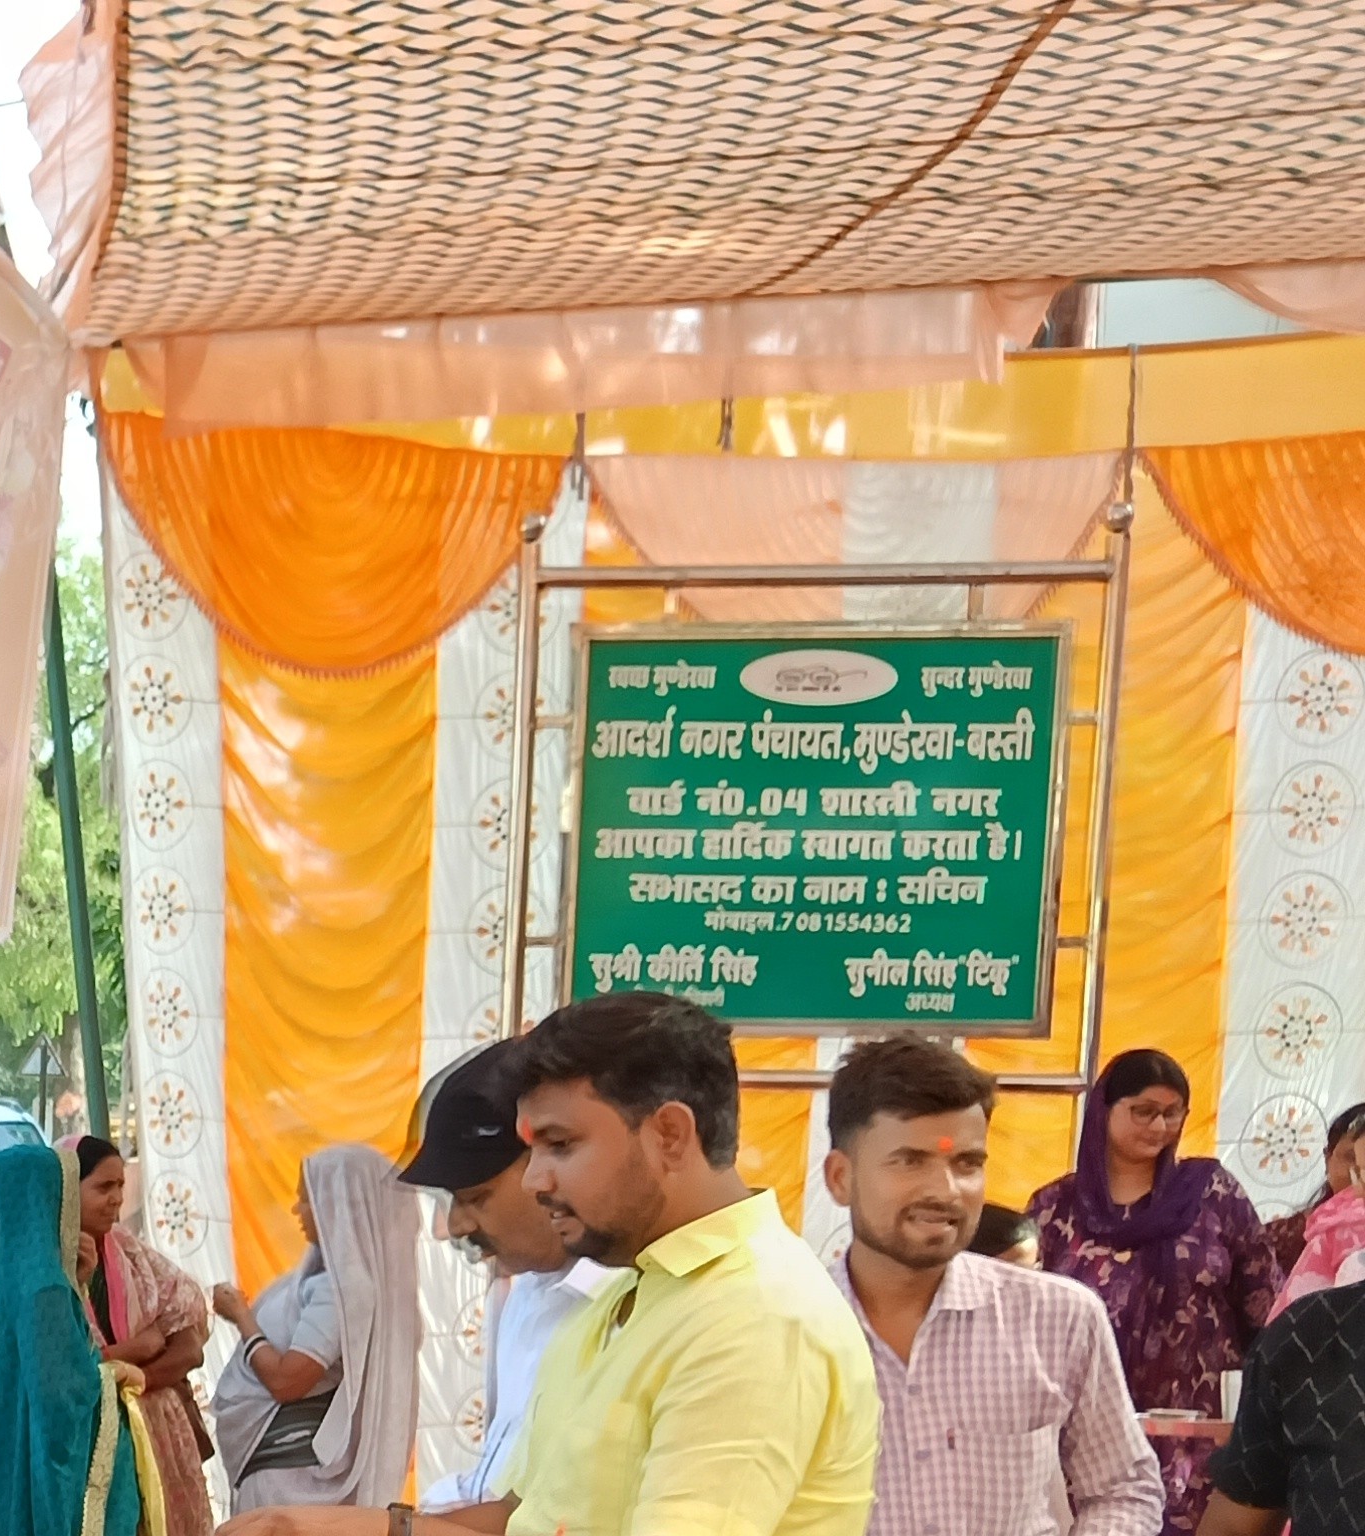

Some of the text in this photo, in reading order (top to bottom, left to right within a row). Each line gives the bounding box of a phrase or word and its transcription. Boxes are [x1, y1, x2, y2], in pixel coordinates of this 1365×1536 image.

[921, 667, 965, 697] सुन्दर
[591, 706, 676, 758] आदर्श
[680, 722, 746, 759] नगर
[627, 780, 686, 815] वार्ड
[931, 788, 1002, 816] नगर
[595, 828, 697, 858] आपका
[701, 821, 795, 859] हार्दिक
[801, 830, 895, 860] स्वागत
[901, 830, 981, 860] करता
[629, 873, 745, 903] सभासद
[752, 876, 797, 904] का
[803, 876, 868, 904] नाम
[898, 867, 988, 904] सचिन
[589, 944, 643, 993] सुश्री
[710, 946, 758, 988] सिंह
[845, 948, 910, 997] सुनील
[913, 950, 959, 988] सिंह
